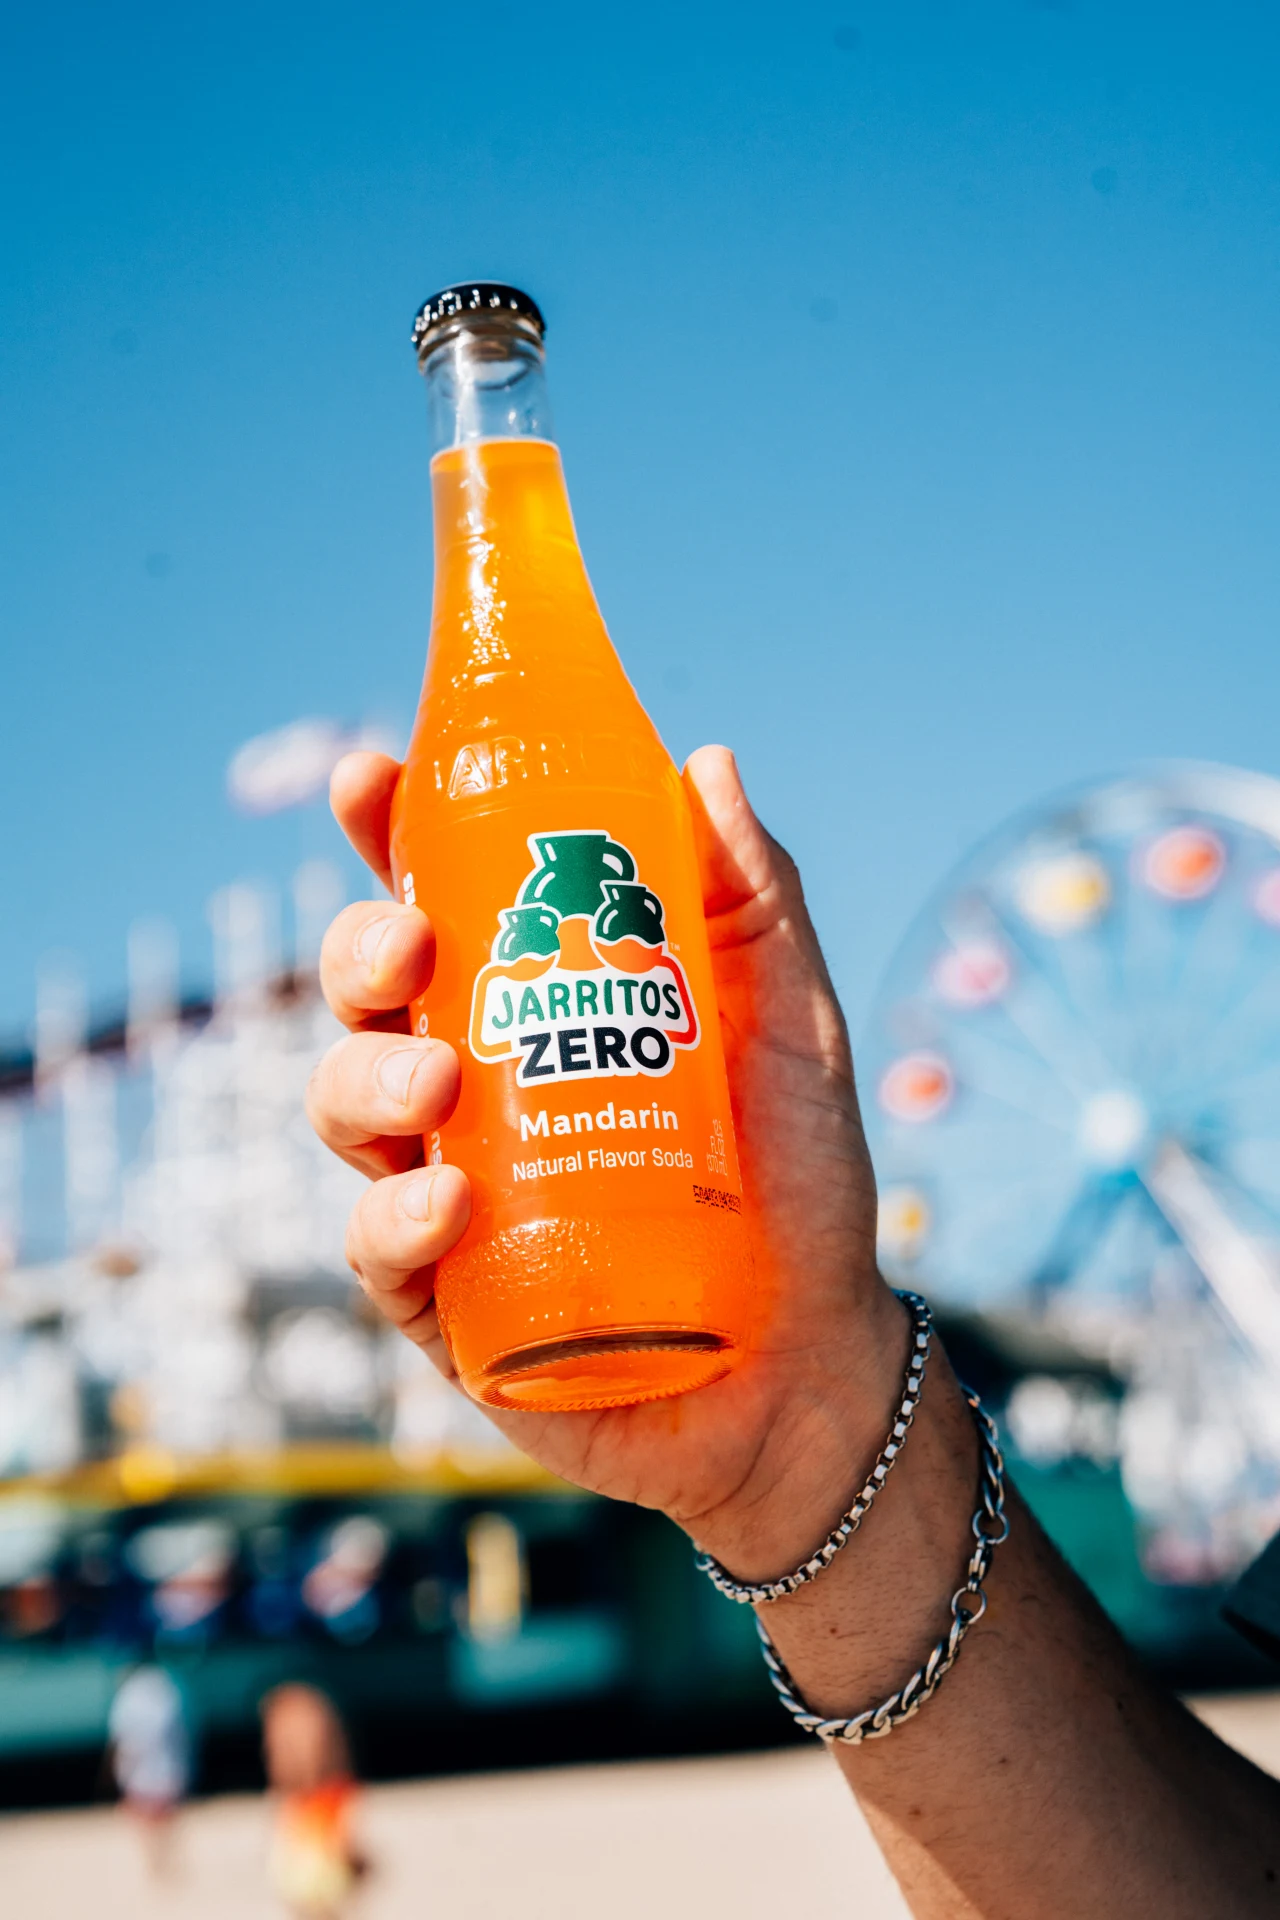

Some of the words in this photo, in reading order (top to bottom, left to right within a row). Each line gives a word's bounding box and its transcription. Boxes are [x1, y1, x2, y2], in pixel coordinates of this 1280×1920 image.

[491, 978, 682, 1029] JARRITOS
[519, 1026, 671, 1079] ZERO
[519, 1102, 679, 1142] Mandarin
[512, 1154, 583, 1182] Natural
[588, 1147, 647, 1169] Flavor
[652, 1147, 694, 1169] Soda
